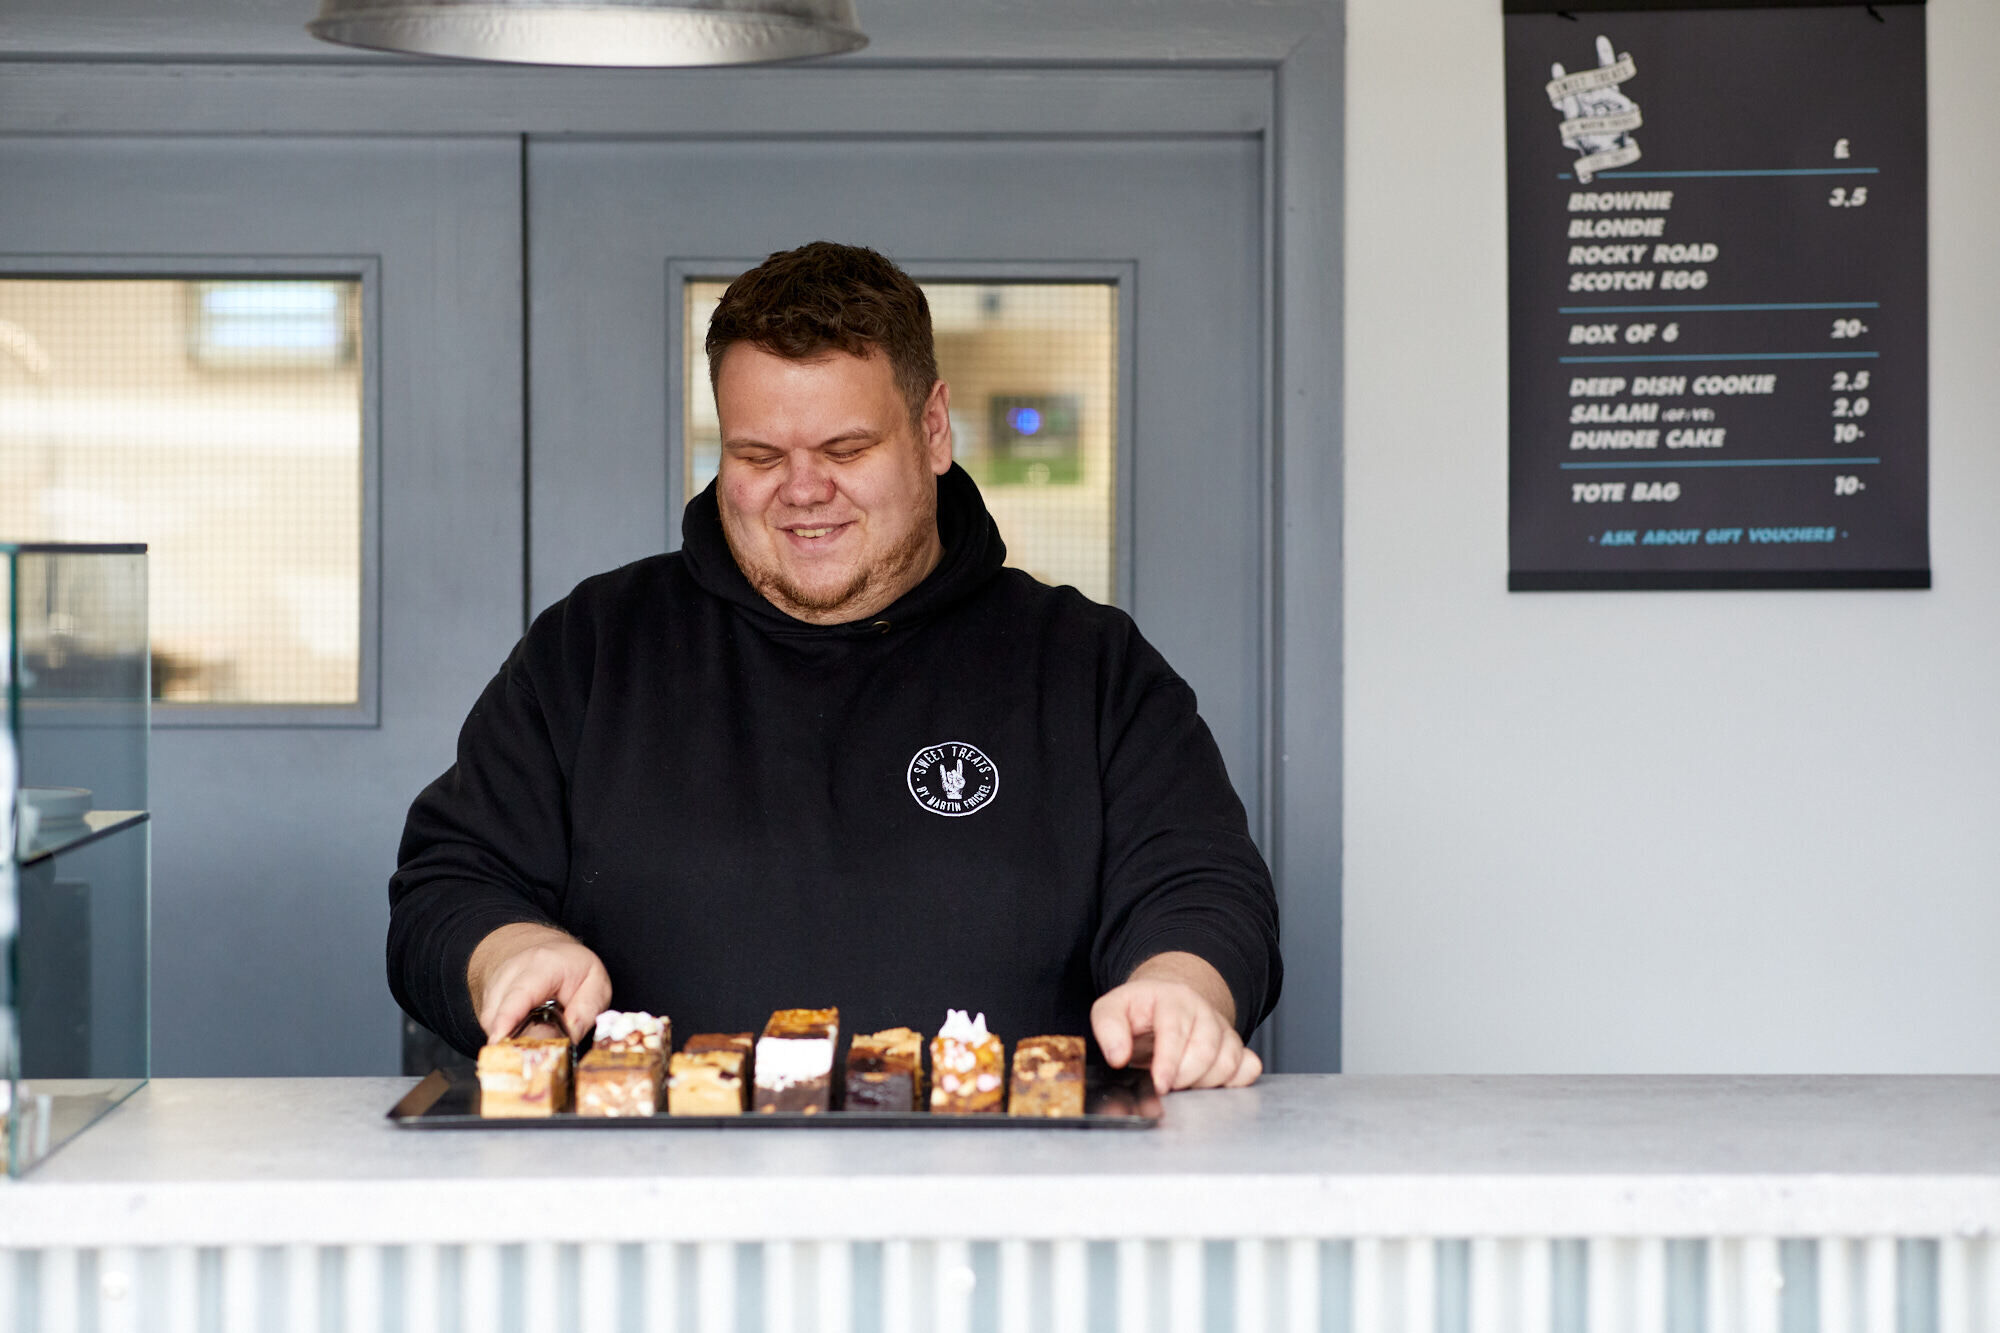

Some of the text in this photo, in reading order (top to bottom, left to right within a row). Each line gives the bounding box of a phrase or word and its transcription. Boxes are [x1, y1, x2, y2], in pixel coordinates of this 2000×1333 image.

[1834, 139, 1850, 159] £
[1568, 191, 1673, 211] BROWNIE
[1829, 187, 1867, 208] 3.5
[1568, 218, 1665, 238] BLONDIE
[1568, 243, 1718, 265] ROCKY ROAD
[1568, 270, 1708, 291] SCOTCH EGG
[1569, 323, 1679, 344] BOX OF 6
[1569, 375, 1776, 397] DEEP DISH COOKIE
[1832, 371, 1869, 391] 2.5
[1569, 403, 1659, 424] SALAMI
[1832, 397, 1869, 417] 2.0
[1569, 428, 1726, 450] DUNDEE CAKE
[1572, 482, 1680, 503] TOTE BAG
[1600, 527, 1836, 546] ASK ABOUT GIFT VOUCHERS
[913, 746, 992, 775] SWEET TREATS
[916, 784, 991, 812] BY MARTIN FRICKEL
